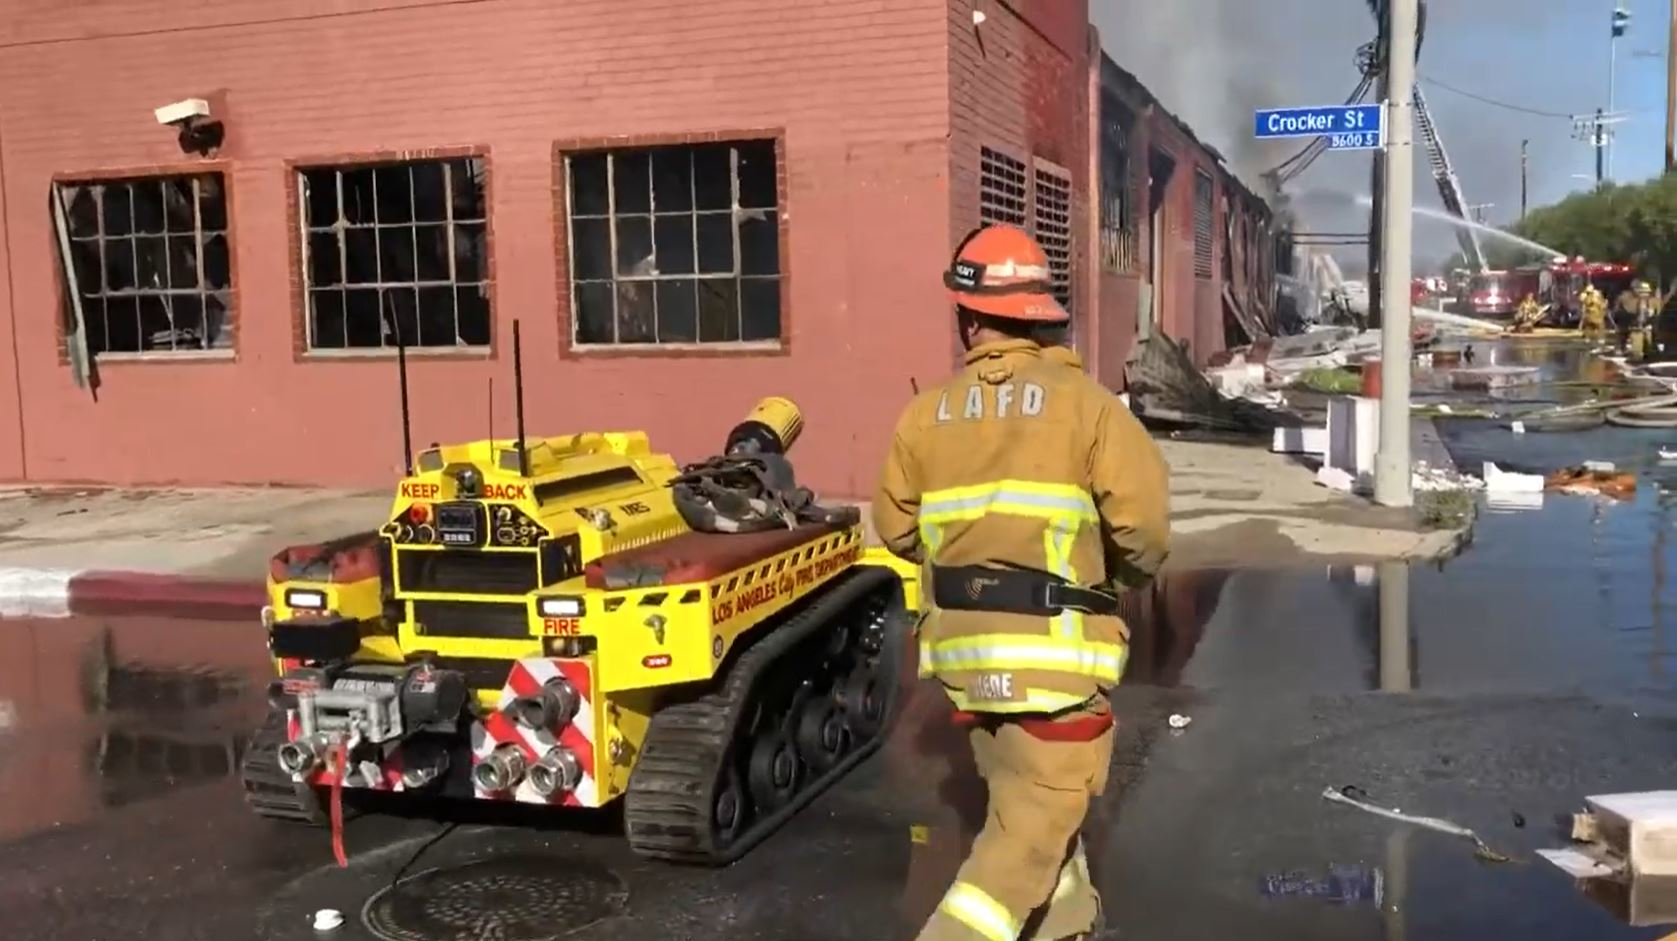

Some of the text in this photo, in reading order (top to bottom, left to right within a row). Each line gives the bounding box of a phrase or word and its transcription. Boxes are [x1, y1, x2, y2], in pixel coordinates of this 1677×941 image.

[1268, 110, 1364, 132] Crocker St
[401, 483, 526, 500] KEEP BACK
[711, 600, 733, 625] LOS
[735, 581, 776, 615] ANGELES
[543, 618, 581, 635] FIRE
